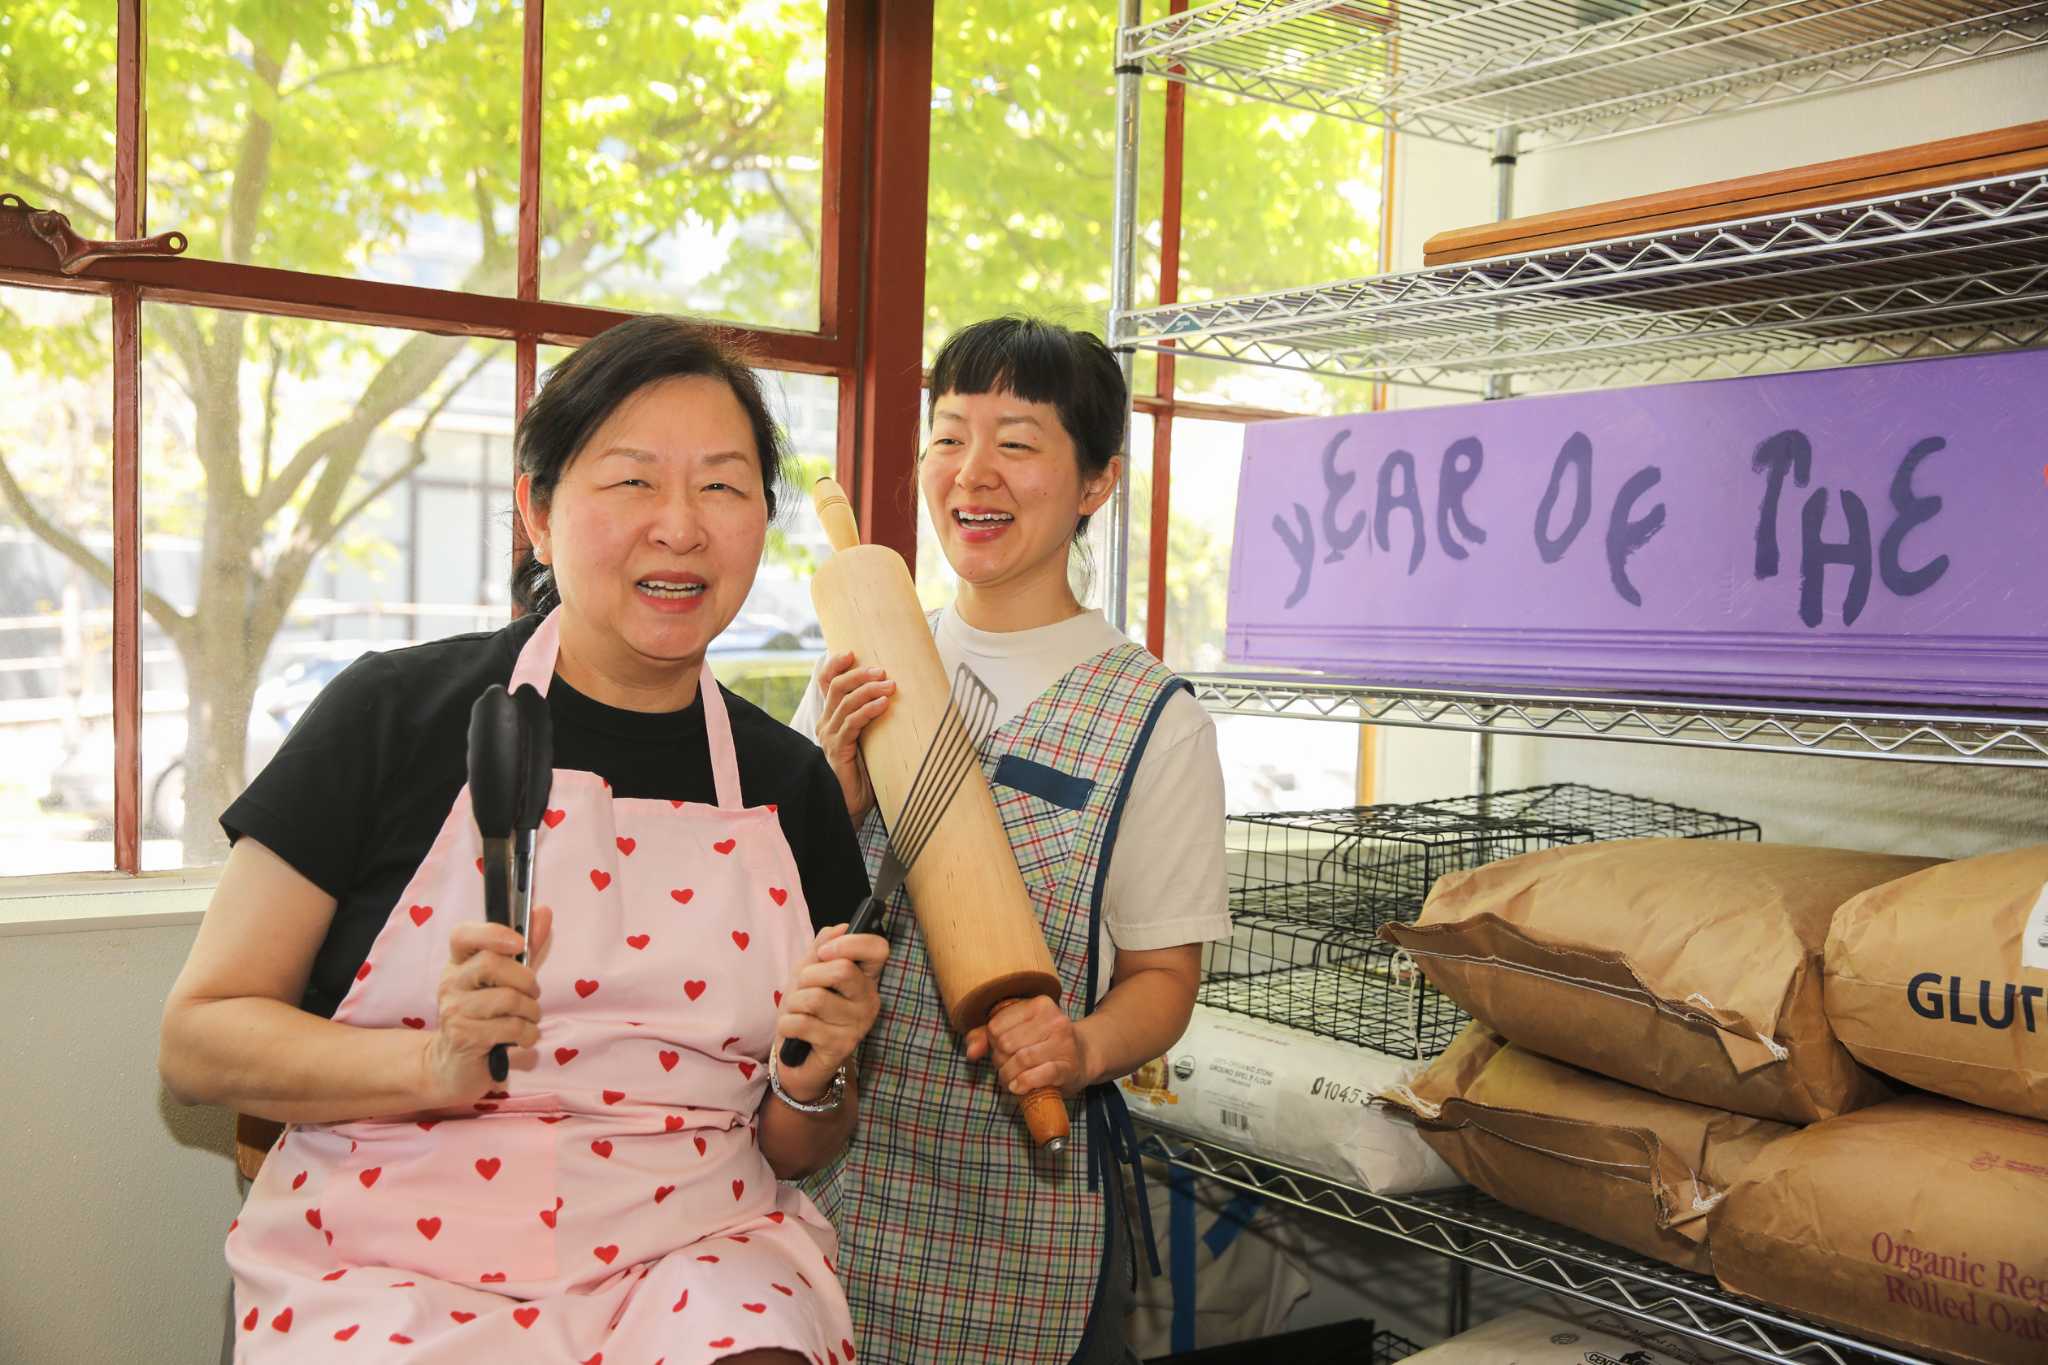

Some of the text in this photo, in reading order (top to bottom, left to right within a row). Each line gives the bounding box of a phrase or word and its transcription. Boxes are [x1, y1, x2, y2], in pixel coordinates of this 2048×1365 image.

[1534, 430, 1667, 607] OF
[1752, 429, 1950, 627] THE
[1907, 972, 2048, 1033] GLUT
[1871, 1231, 1985, 1287] Organic
[1883, 1273, 1979, 1327] Rolled
